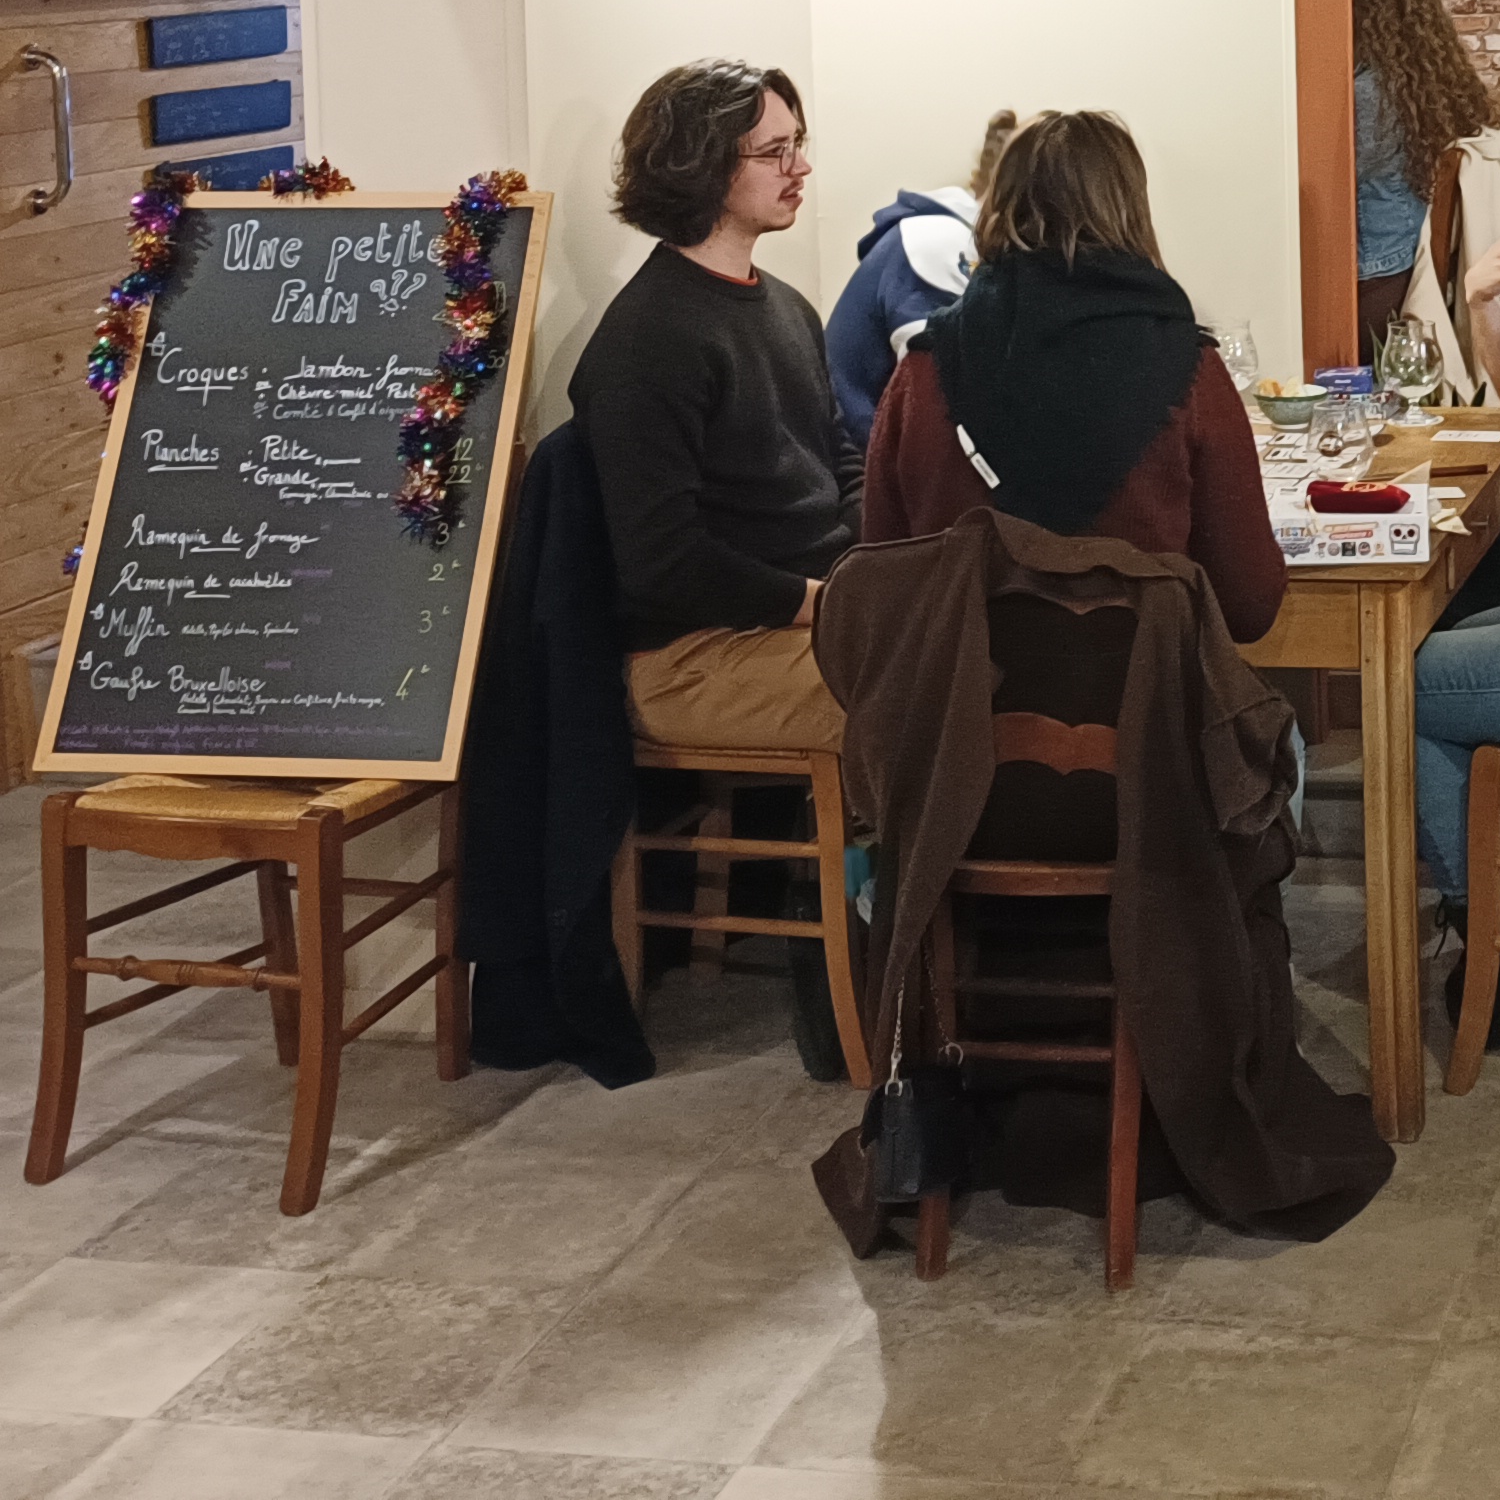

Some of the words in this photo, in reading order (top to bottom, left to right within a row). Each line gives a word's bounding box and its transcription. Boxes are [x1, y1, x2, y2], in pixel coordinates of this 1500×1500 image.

[157, 347, 249, 406] Croques
[387, 382, 424, 399] Pest
[254, 467, 319, 486] Grande
[124, 514, 212, 559] Ramequin
[221, 526, 244, 544] de
[245, 522, 320, 559] fromage
[109, 561, 195, 606] Ramequin
[203, 574, 222, 588] de
[99, 606, 170, 657] Muffin
[91, 661, 161, 700] Gaufre
[168, 665, 267, 693] Bruxelloise
